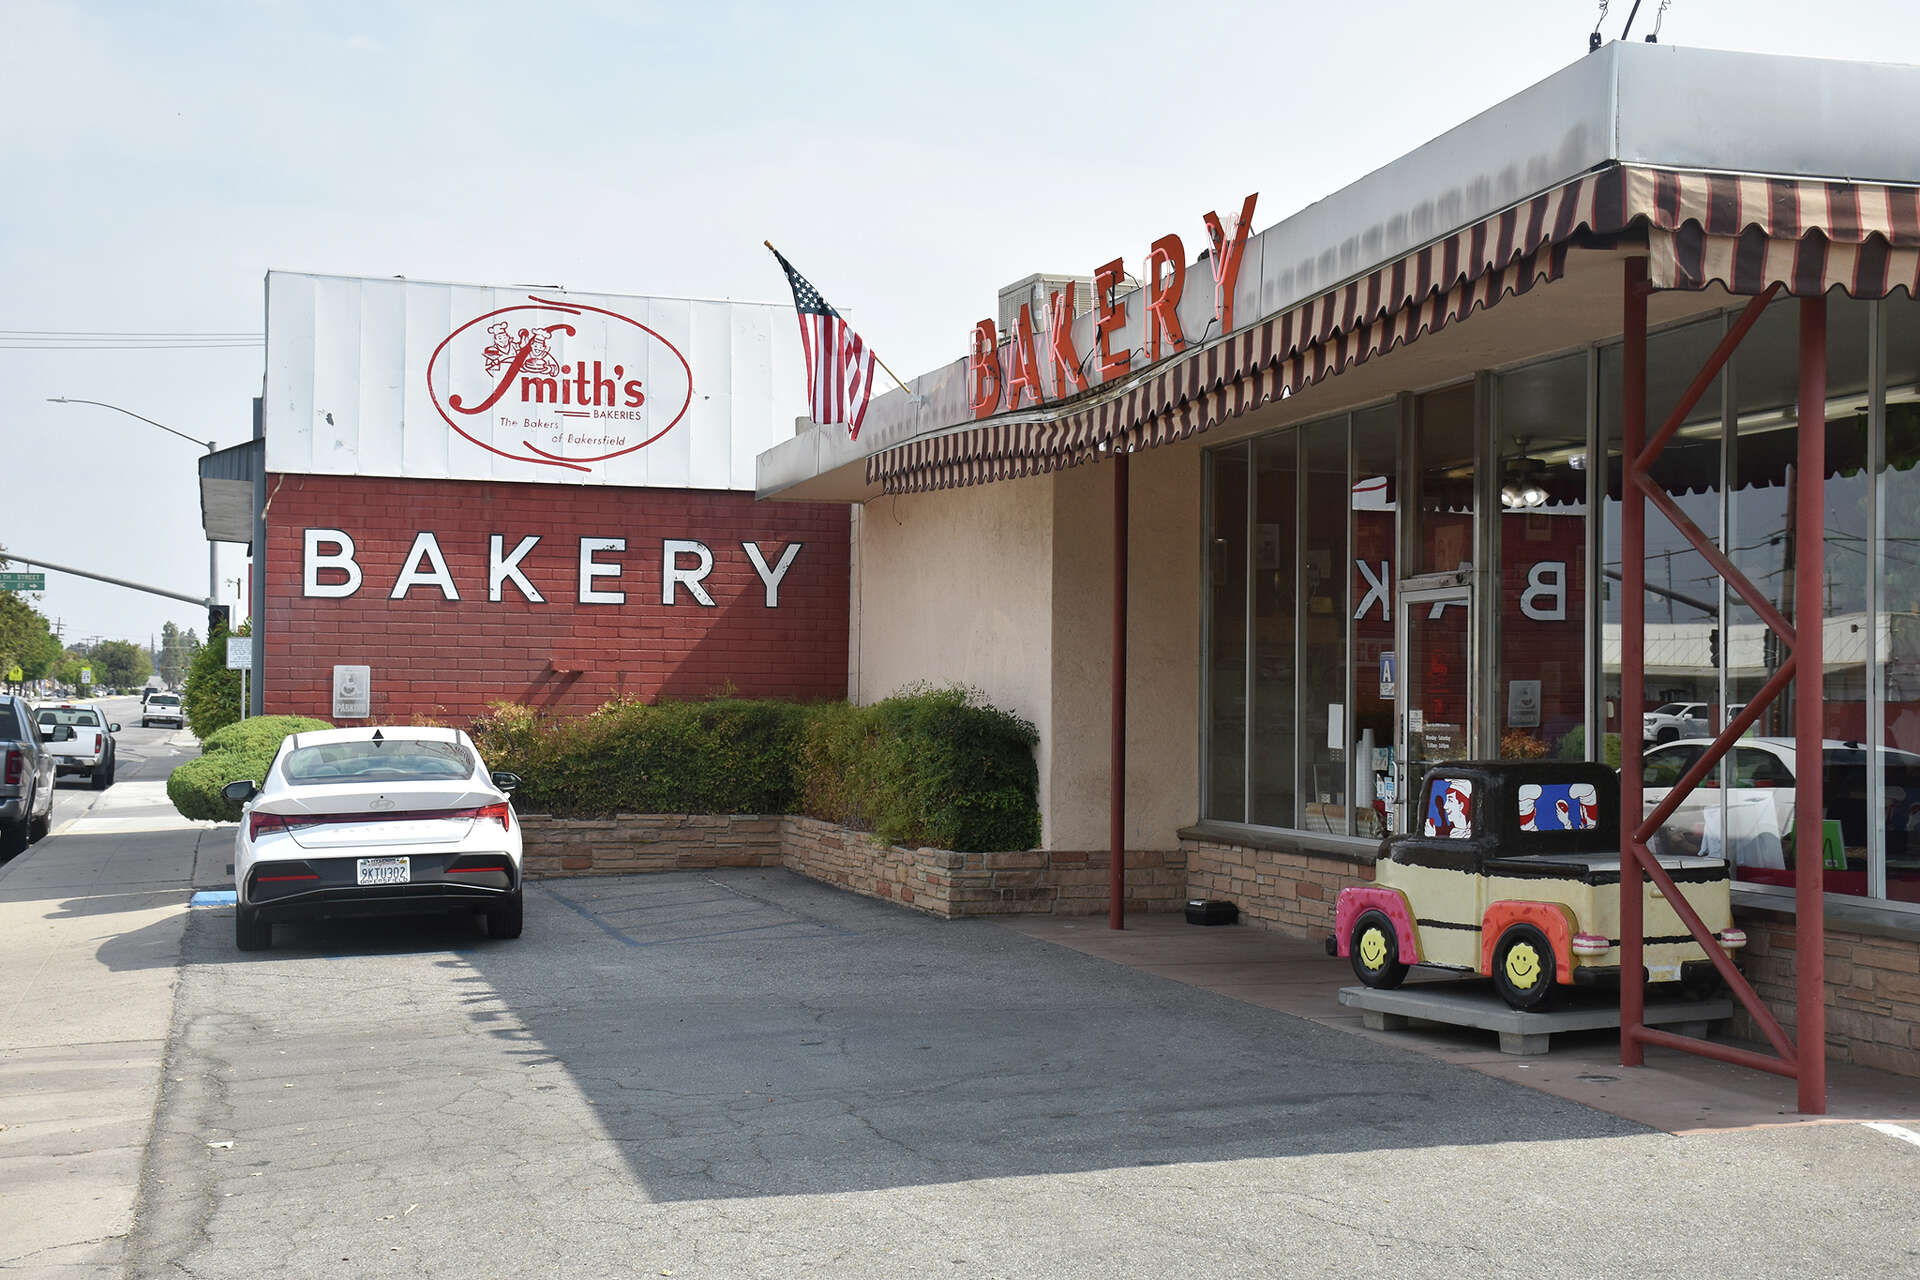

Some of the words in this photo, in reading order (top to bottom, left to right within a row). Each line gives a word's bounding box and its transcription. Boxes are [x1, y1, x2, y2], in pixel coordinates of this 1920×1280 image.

[968, 192, 1259, 420] BAKERY
[449, 324, 646, 414] Smith's
[500, 417, 518, 427] The
[523, 418, 559, 429] Bakers
[593, 409, 642, 421] BAKERIES
[551, 433, 563, 443] of
[567, 434, 626, 446] Bakersfield
[303, 526, 803, 609] BAKERY
[1383, 660, 1392, 682] A
[361, 866, 406, 881] 9KTU302
